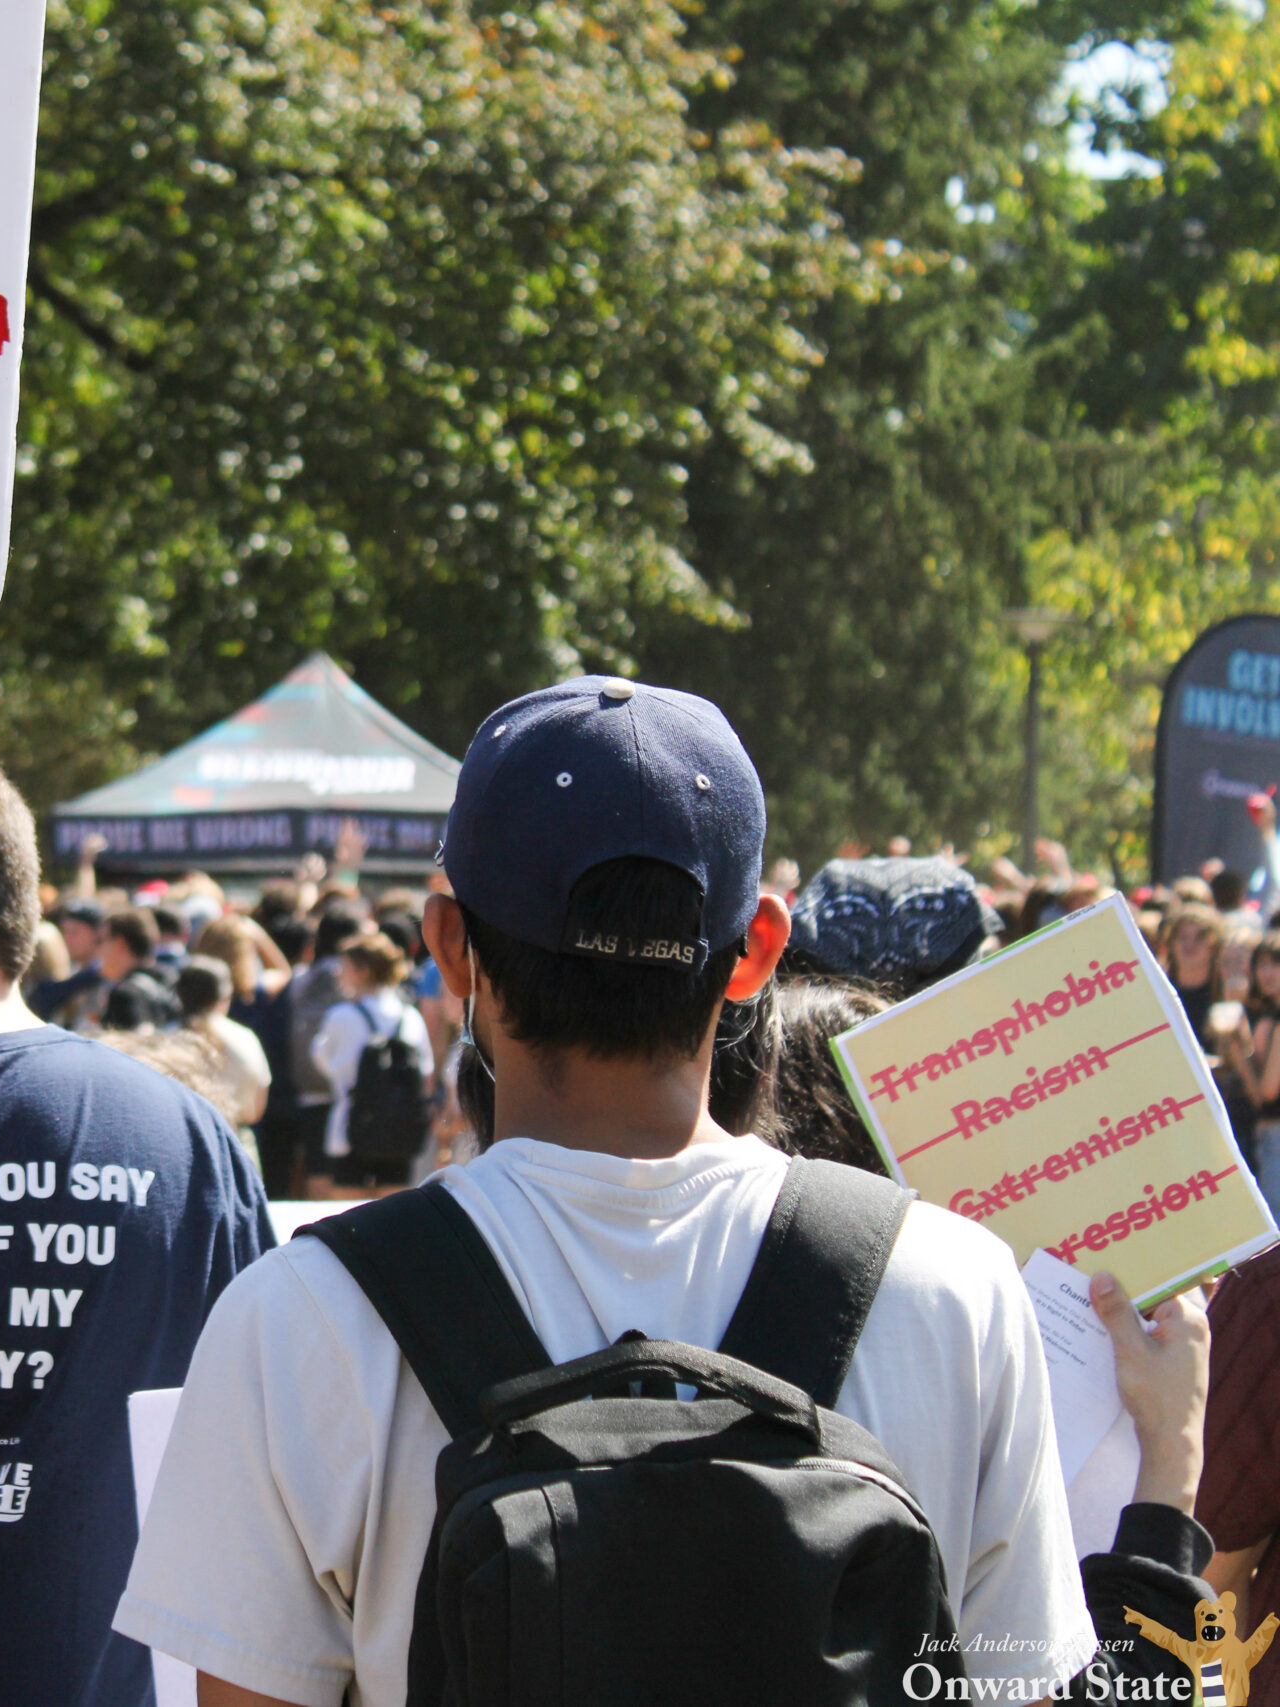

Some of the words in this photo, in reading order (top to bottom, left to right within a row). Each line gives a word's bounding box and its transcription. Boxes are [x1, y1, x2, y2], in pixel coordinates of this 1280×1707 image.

[306, 816, 391, 848] PRVE
[576, 929, 619, 953] LAS
[870, 960, 1139, 1103] Transphobia
[951, 1046, 1111, 1140] Racism
[948, 1096, 1186, 1223] Extremism
[70, 1163, 155, 1207] SAY
[1044, 1170, 1222, 1265] ression
[27, 1223, 116, 1266] YOU
[9, 1288, 83, 1328] MY
[1060, 1283, 1091, 1308] Chants
